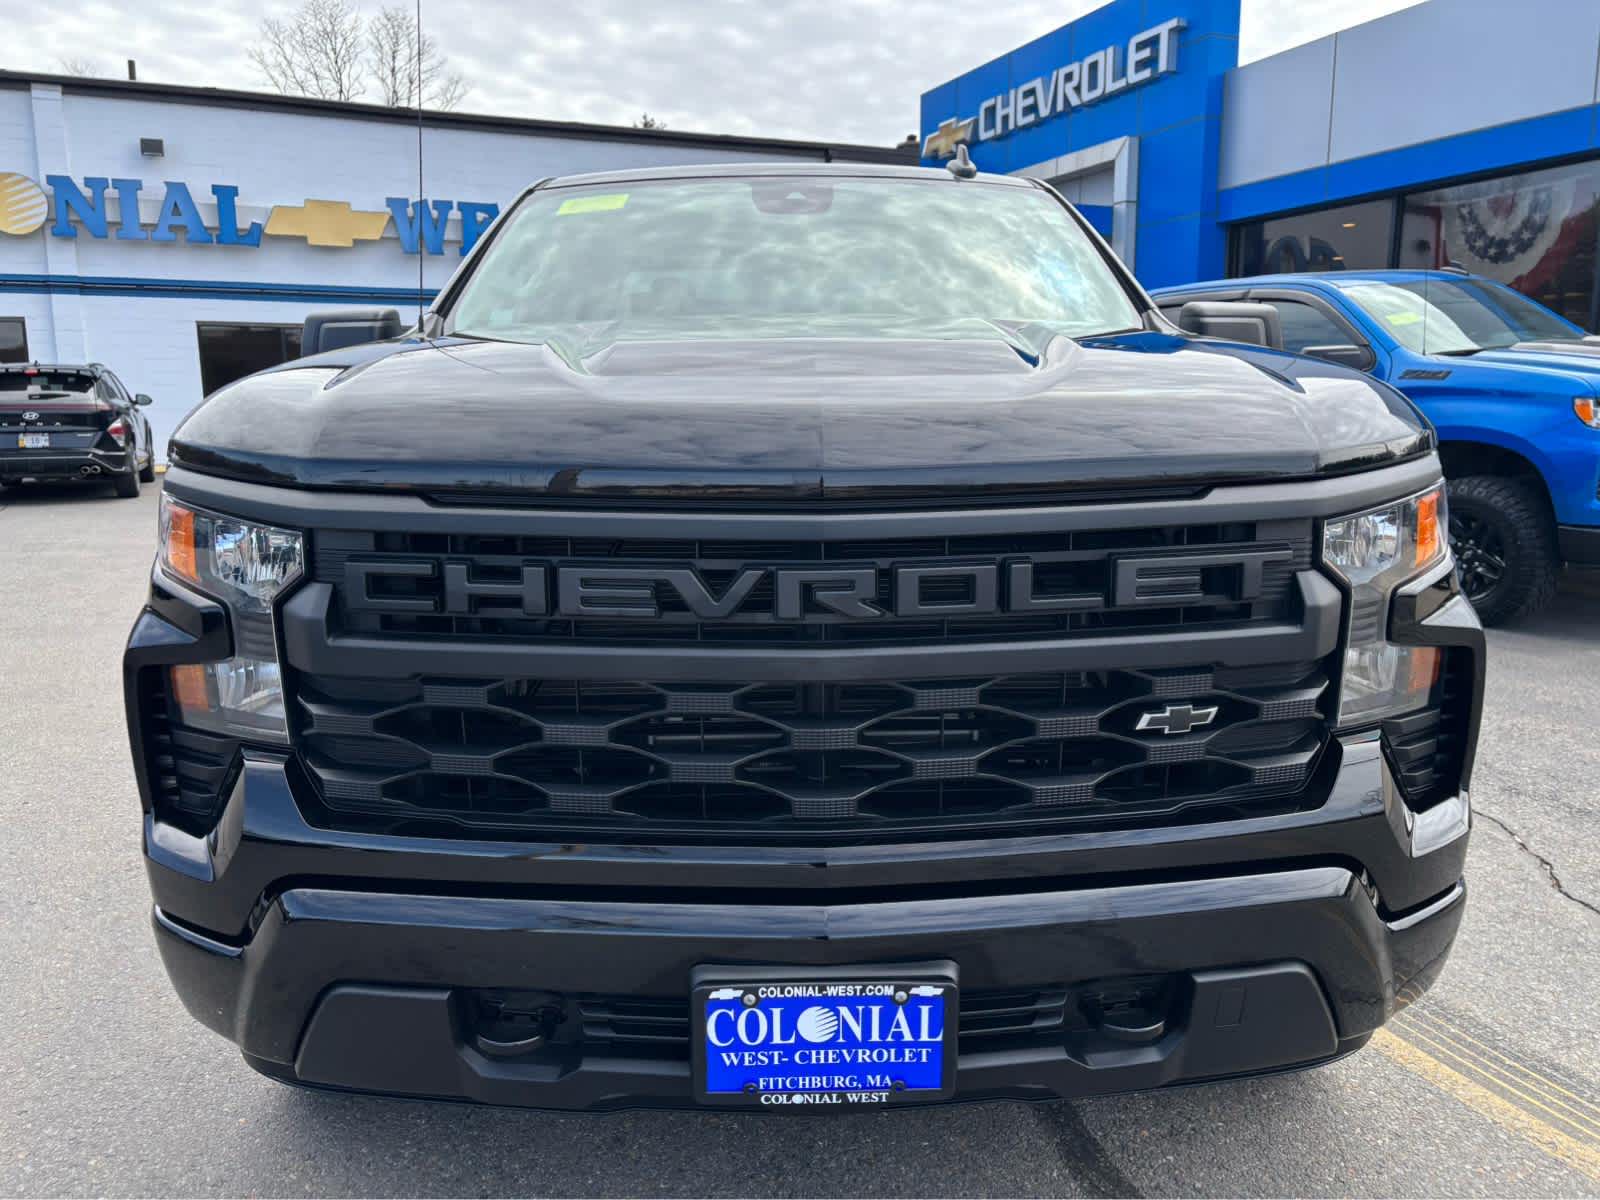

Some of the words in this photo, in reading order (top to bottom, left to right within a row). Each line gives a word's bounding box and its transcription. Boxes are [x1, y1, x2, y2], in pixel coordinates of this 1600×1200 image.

[978, 17, 1186, 141] CHEVROLET
[344, 544, 1294, 619] CHEVROLET
[758, 985, 894, 998] COLONIAL-WEST.COM
[706, 1005, 943, 1047] COLONIAL
[794, 1048, 932, 1065] CHEVROLET
[759, 1074, 861, 1090] FITCHBURG,
[866, 1074, 892, 1088] MA
[760, 1092, 841, 1105] COLONIAL
[846, 1092, 888, 1103] WEST
